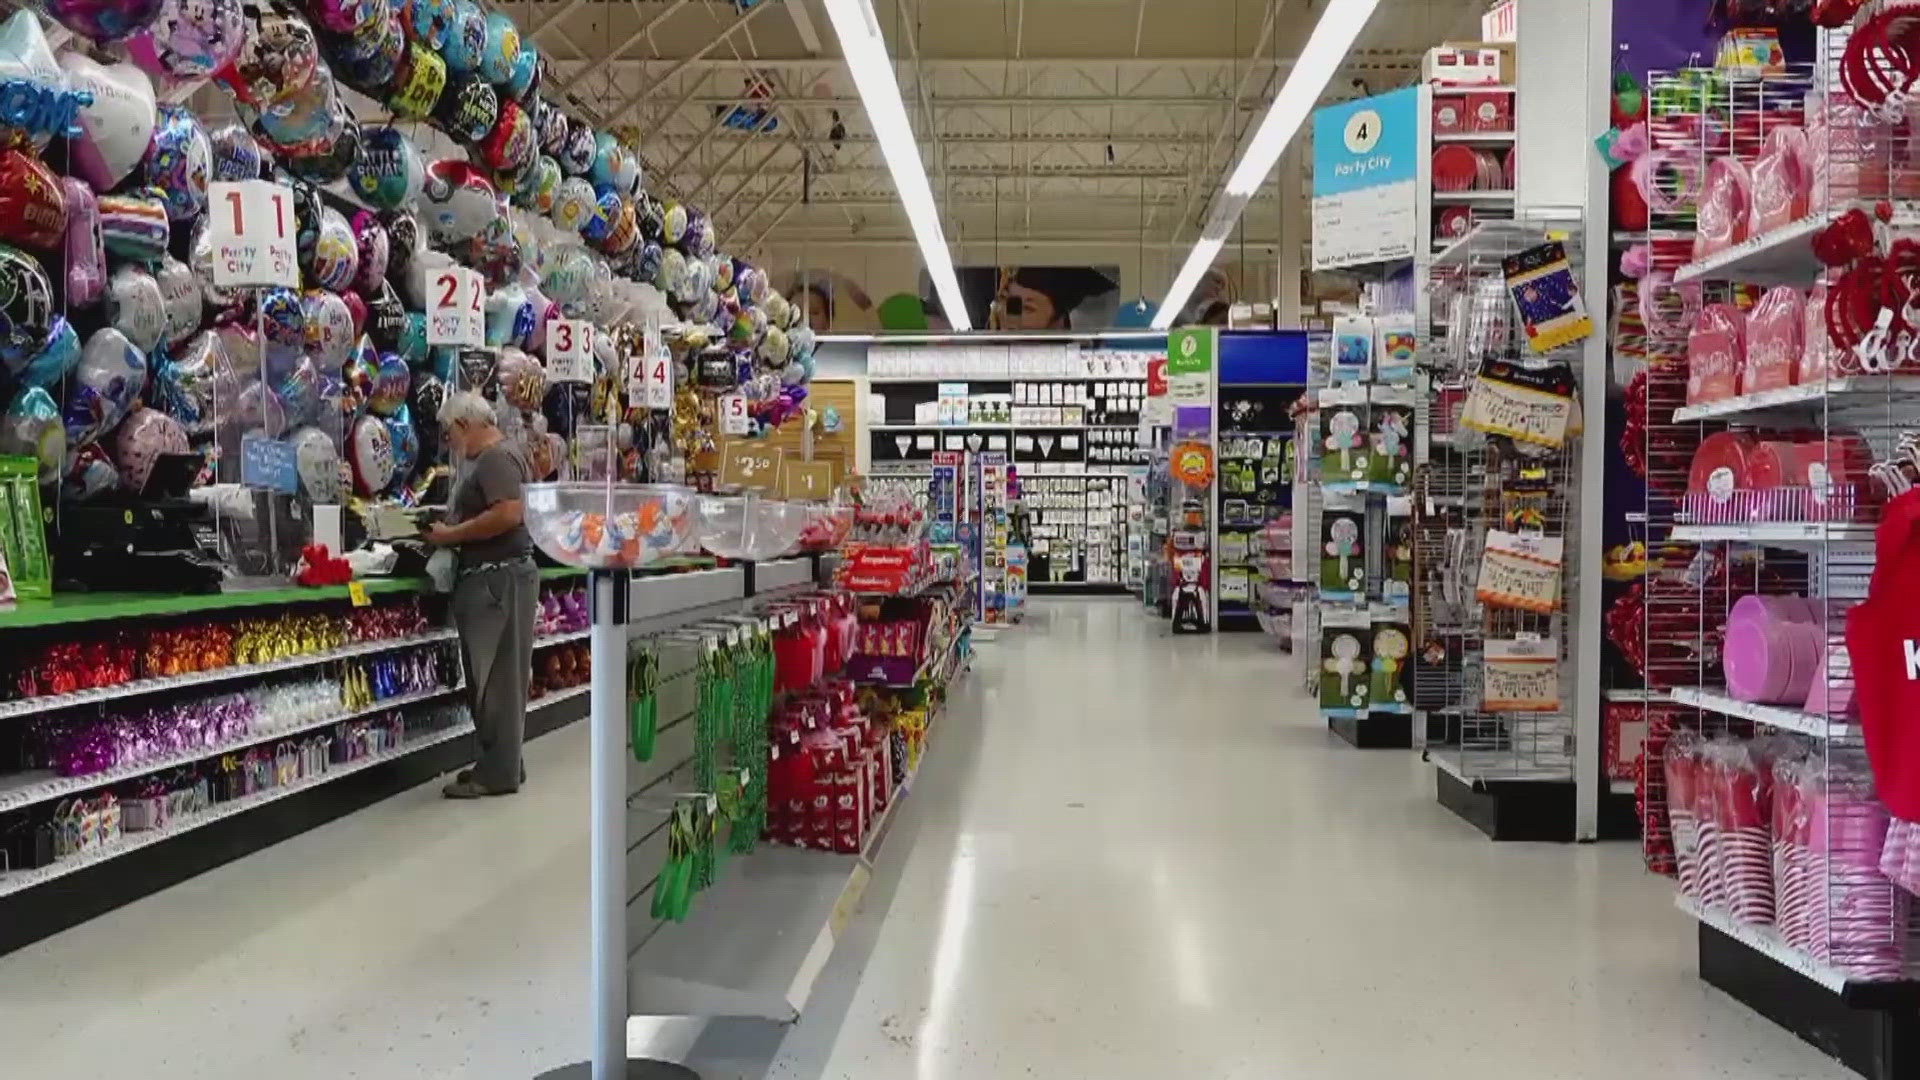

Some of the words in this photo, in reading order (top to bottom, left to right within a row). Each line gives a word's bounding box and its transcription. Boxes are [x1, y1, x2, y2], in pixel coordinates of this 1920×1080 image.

[1356, 122, 1368, 140] 4
[226, 192, 244, 236] 1
[272, 194, 284, 239] 1
[227, 261, 252, 276] City
[437, 274, 458, 308] 2
[471, 279, 481, 313] 2
[555, 324, 573, 353] 3
[583, 326, 591, 354] 3
[633, 361, 645, 383] 4
[653, 360, 666, 384] 4
[731, 399, 743, 417] 5
